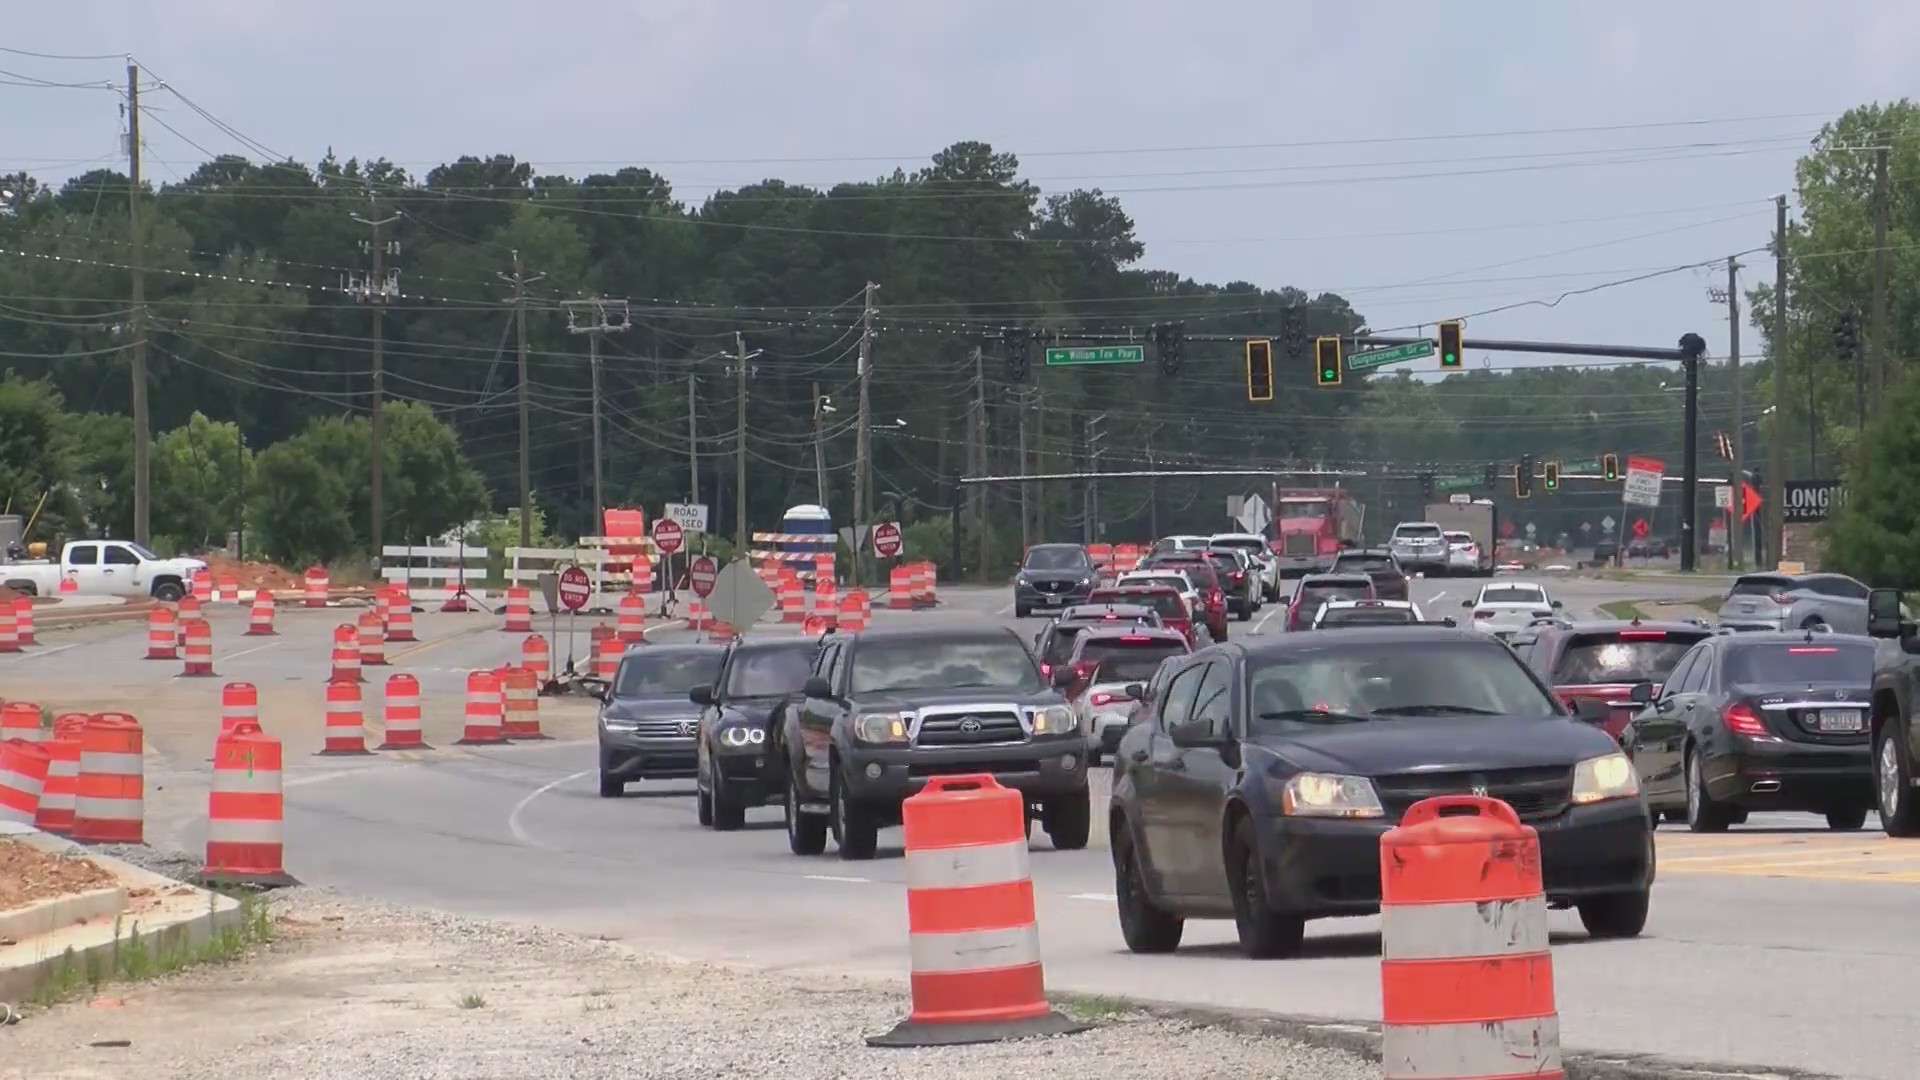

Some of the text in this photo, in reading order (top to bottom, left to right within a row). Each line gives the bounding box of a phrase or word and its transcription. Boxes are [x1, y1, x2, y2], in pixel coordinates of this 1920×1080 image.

[1069, 350, 1095, 361] William
[673, 507, 698, 517] ROAD
[1783, 508, 1828, 516] STEAK
[682, 519, 703, 528] SED
[563, 573, 587, 584] DO NOT
[564, 593, 583, 602] ENTER
